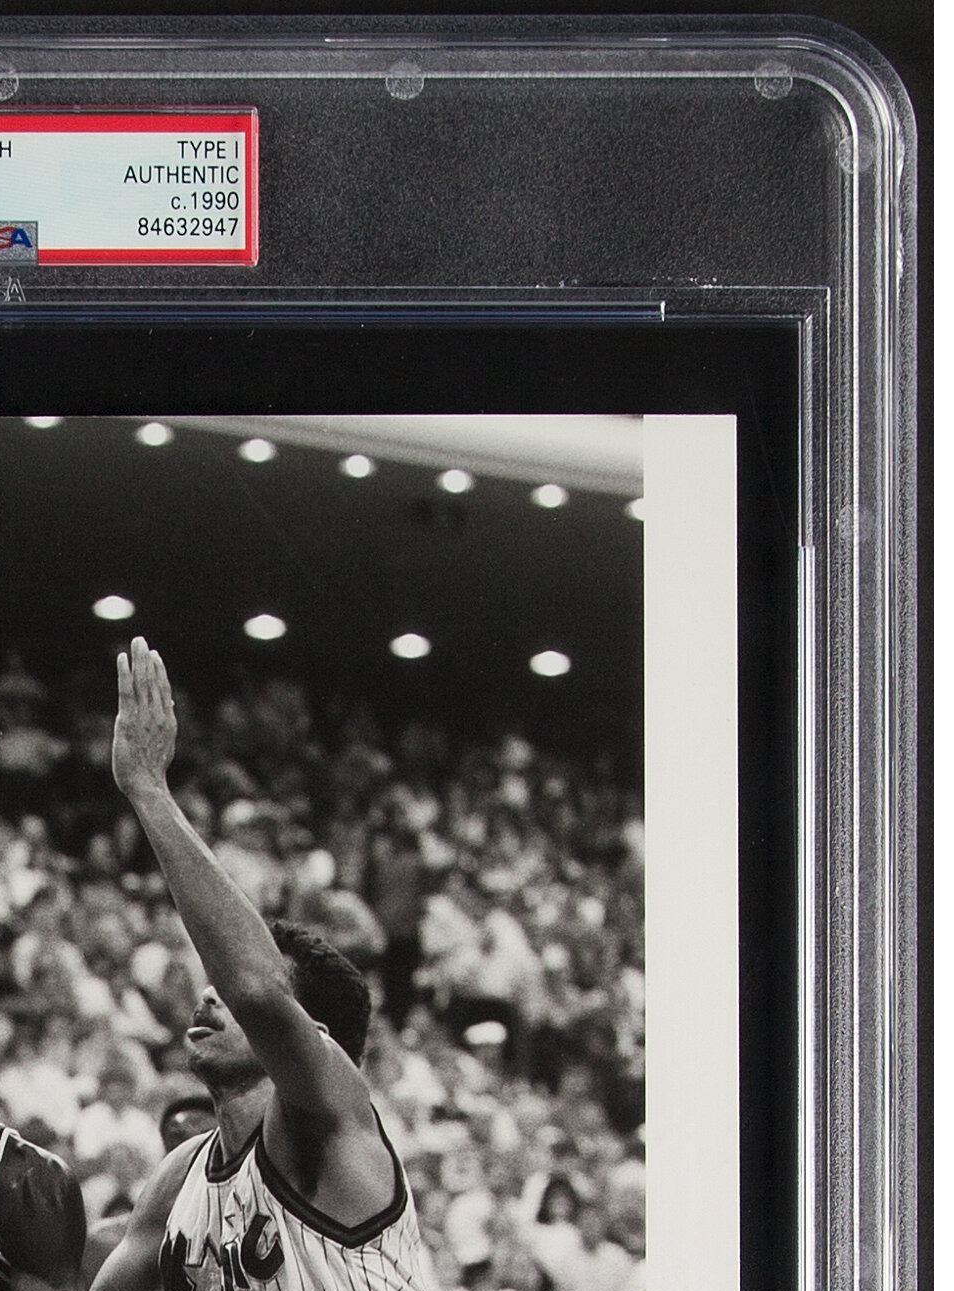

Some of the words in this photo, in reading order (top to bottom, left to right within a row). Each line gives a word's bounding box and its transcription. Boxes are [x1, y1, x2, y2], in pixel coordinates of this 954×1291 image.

[176, 140, 227, 160] TYPE
[234, 140, 240, 160] I
[123, 165, 239, 185] AUTHENTIC
[170, 191, 240, 211] c.1990
[137, 217, 239, 237] 84632947
